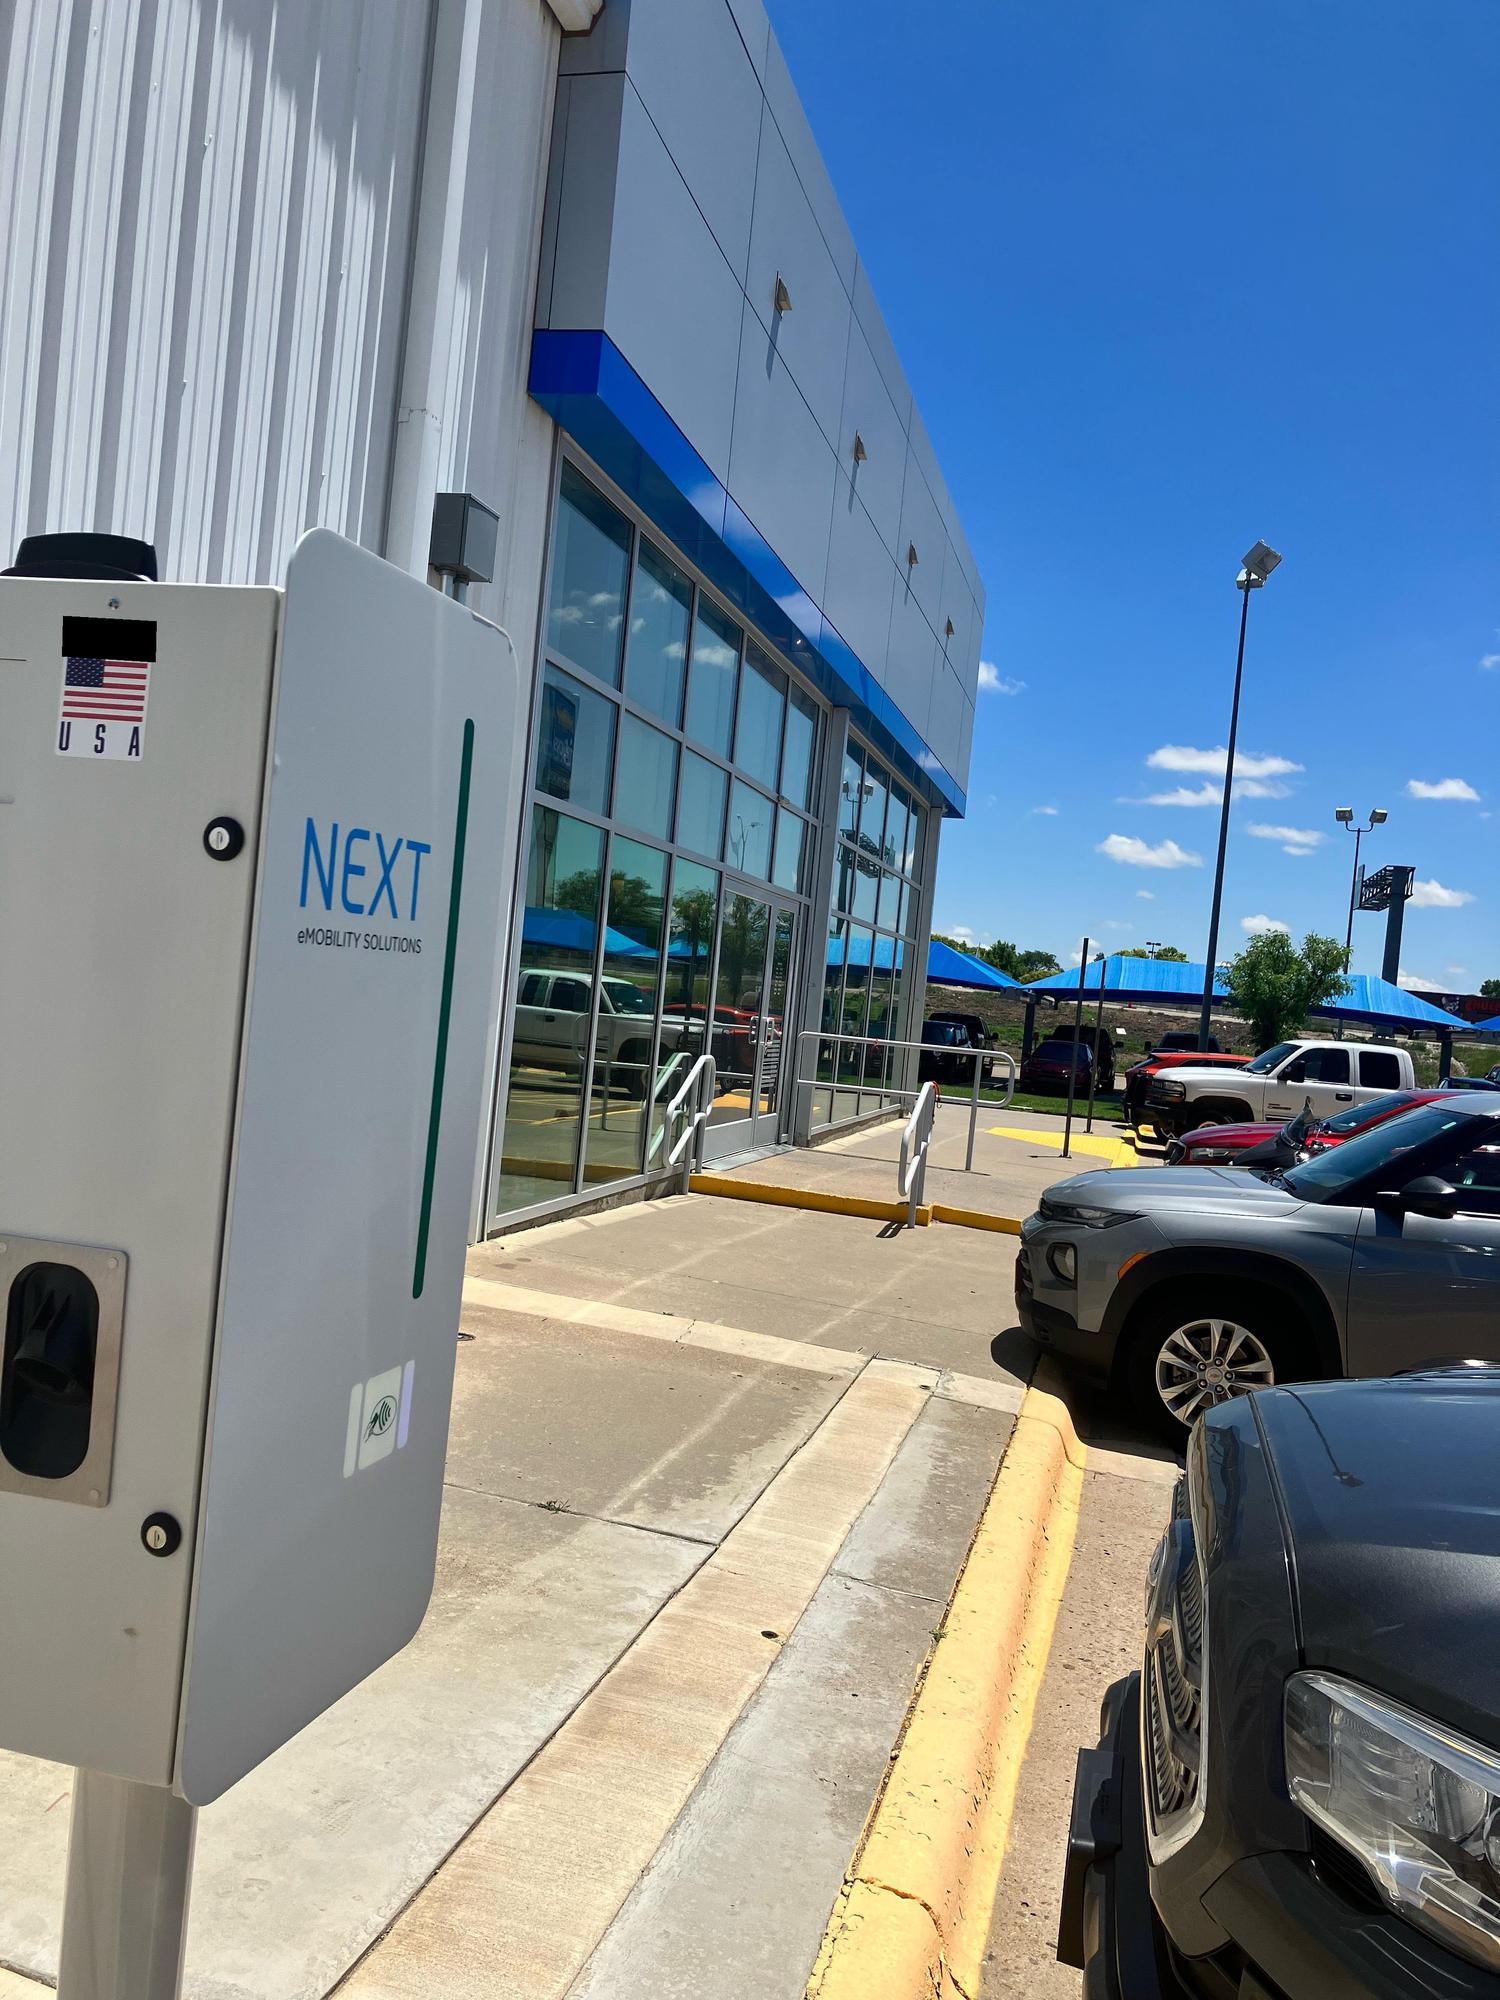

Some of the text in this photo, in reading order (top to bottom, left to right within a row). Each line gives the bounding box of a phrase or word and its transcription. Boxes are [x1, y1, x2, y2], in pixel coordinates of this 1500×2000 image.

[299, 817, 431, 921] NEXT
[297, 927, 422, 954] eMOBILITY SOLUTIONS
